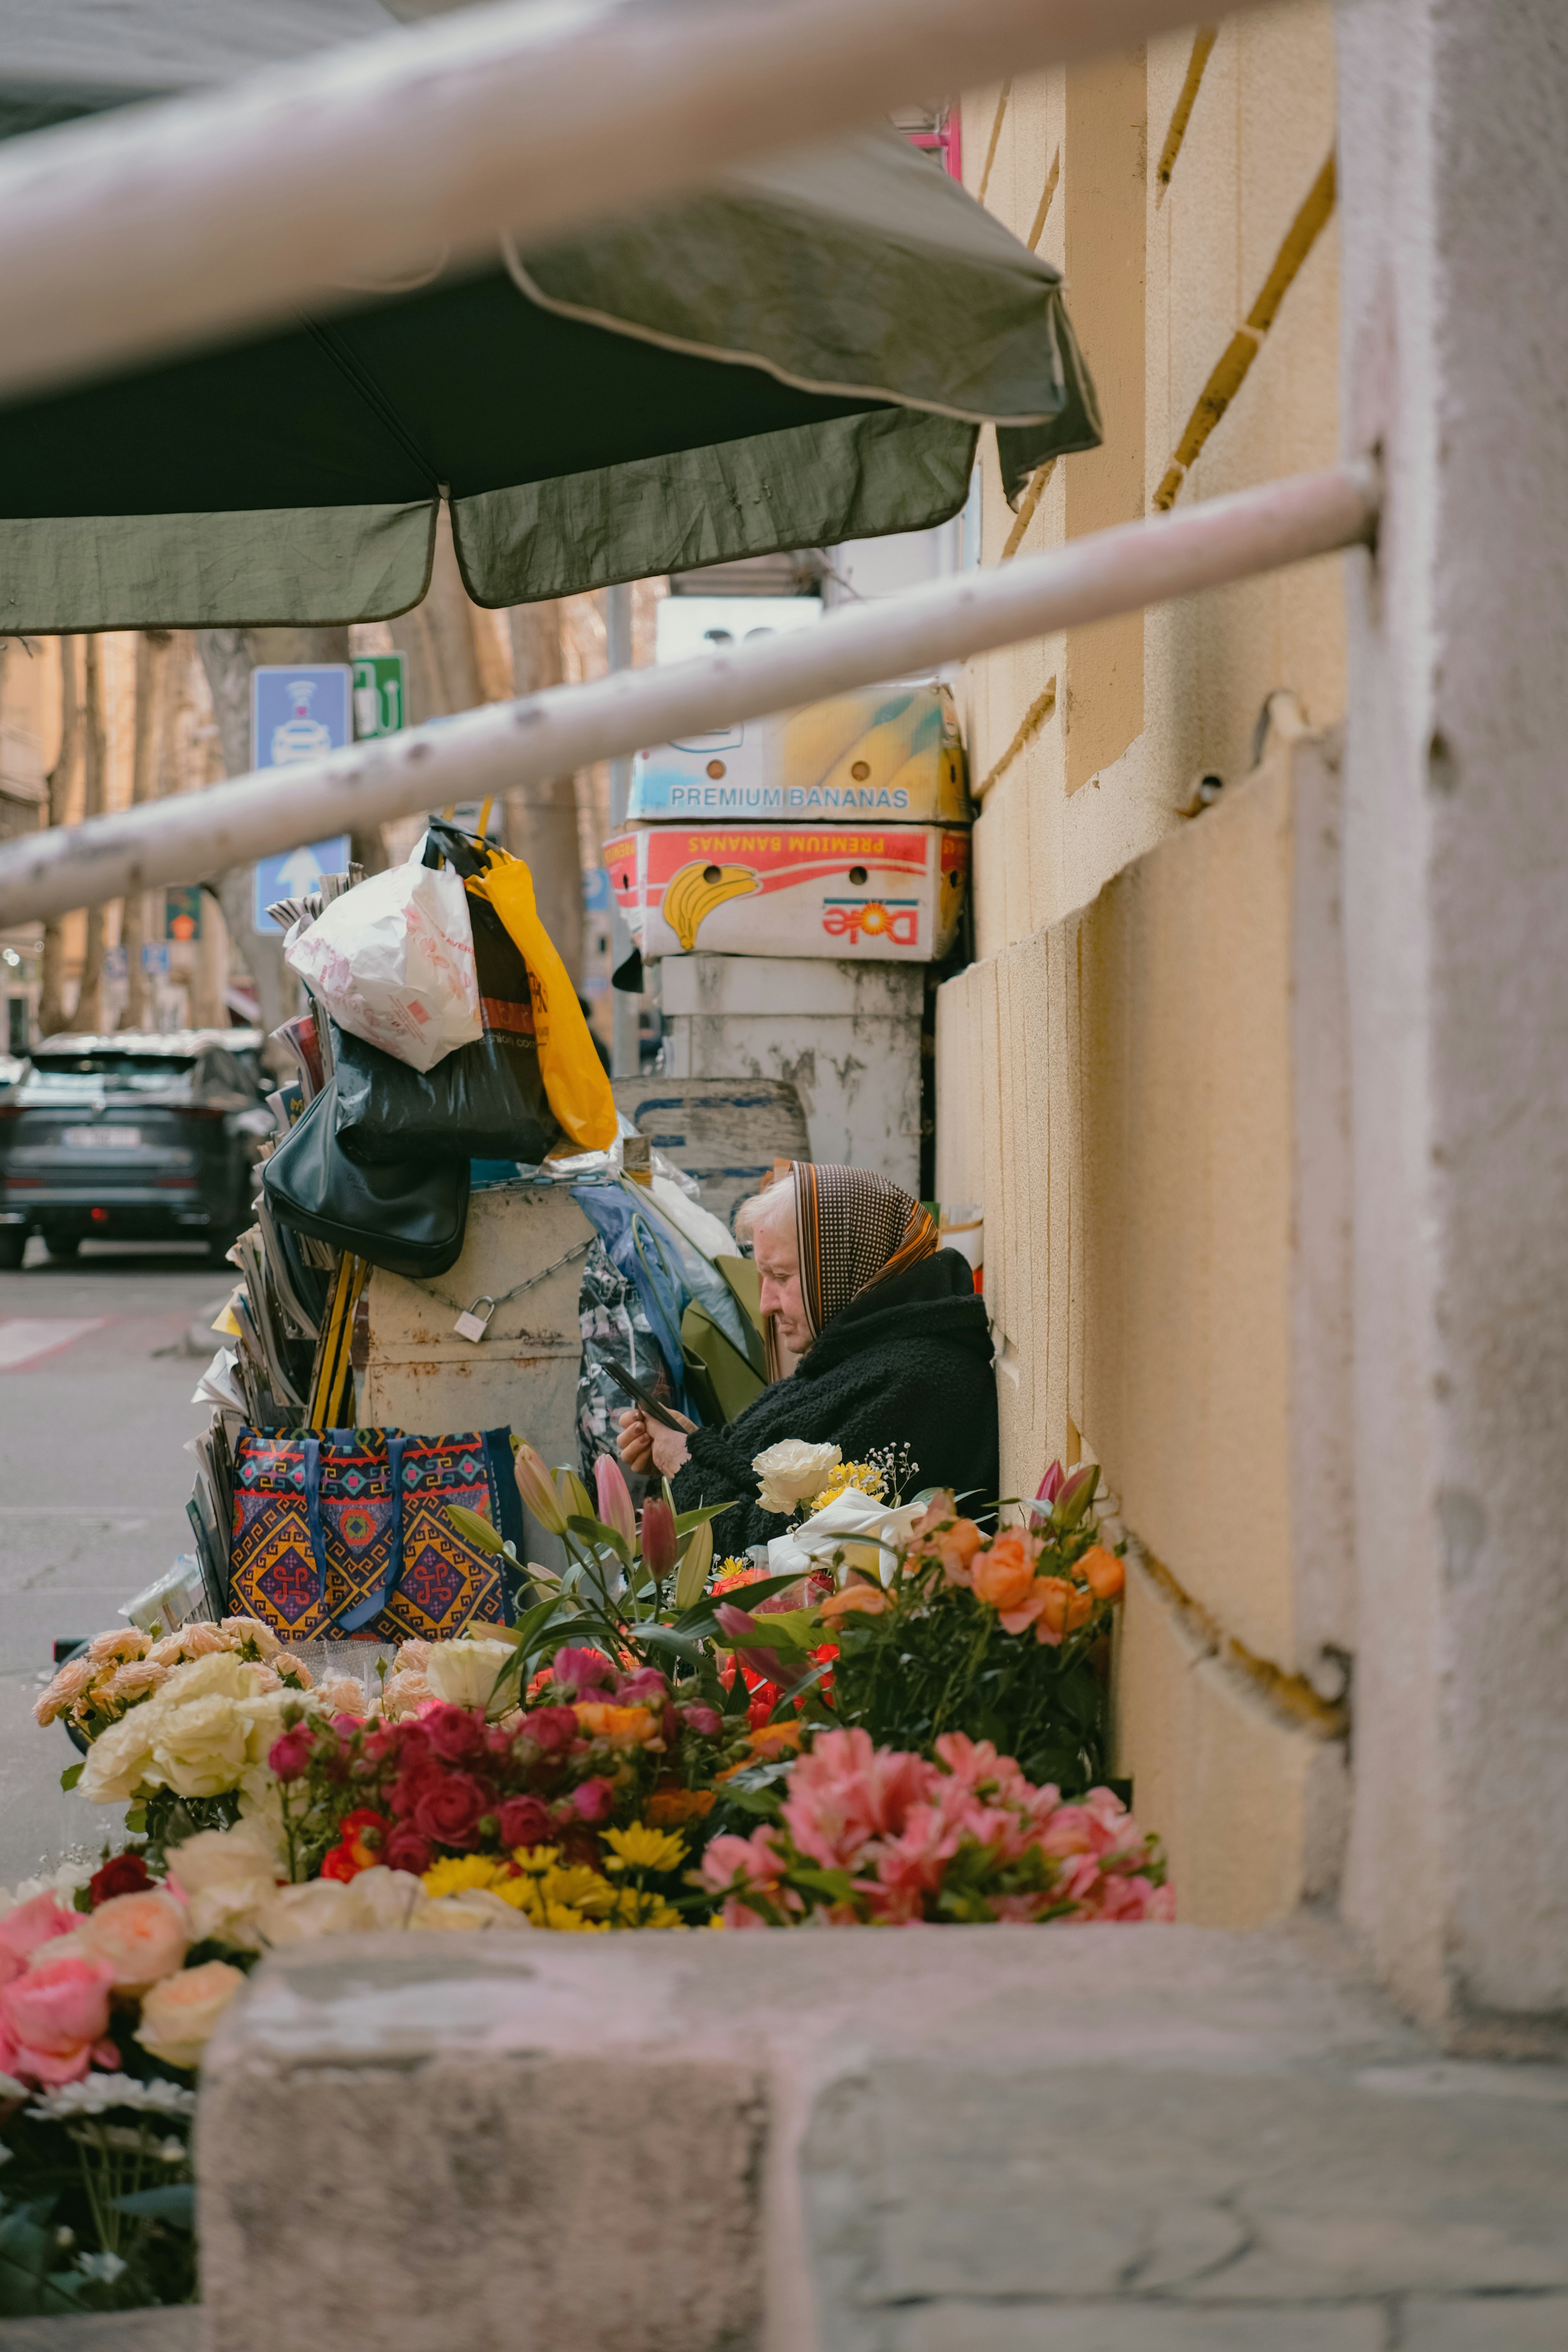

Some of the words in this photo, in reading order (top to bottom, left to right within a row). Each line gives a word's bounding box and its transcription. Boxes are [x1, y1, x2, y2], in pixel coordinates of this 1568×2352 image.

[671, 787, 781, 806] PREMIUM
[790, 788, 909, 808] BANANAS
[688, 836, 781, 853] BANANAS
[789, 836, 885, 853] PREMIUM
[822, 902, 919, 946] Dole
